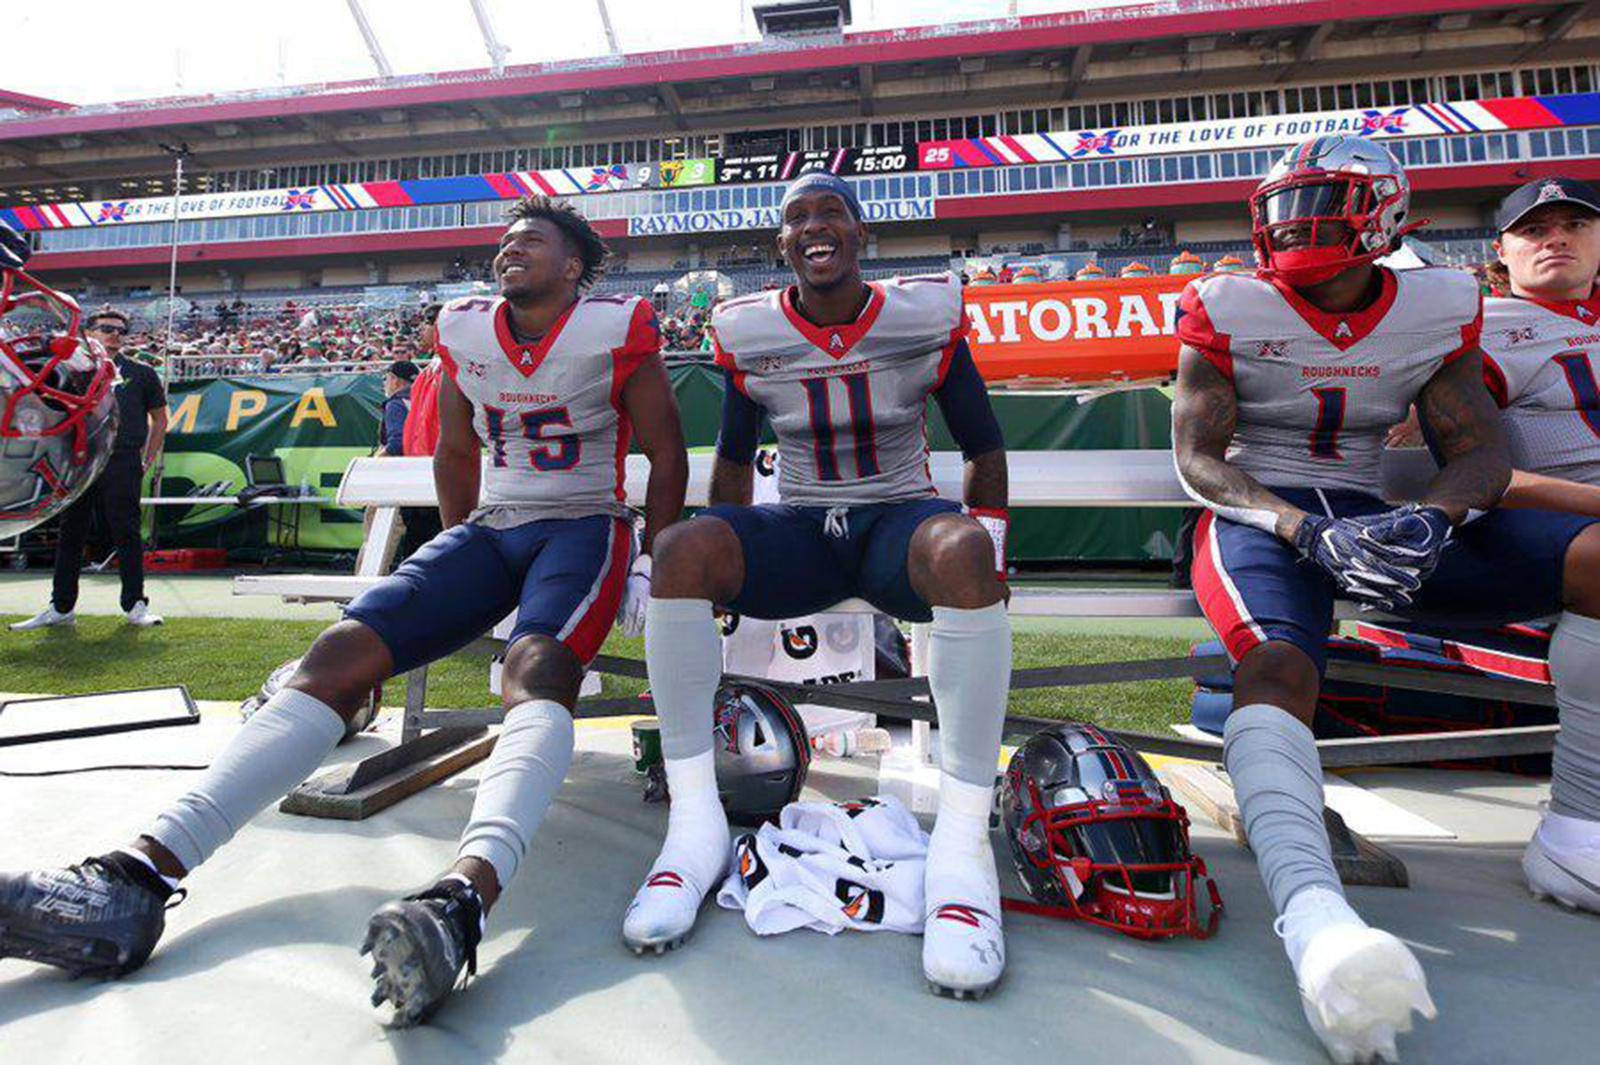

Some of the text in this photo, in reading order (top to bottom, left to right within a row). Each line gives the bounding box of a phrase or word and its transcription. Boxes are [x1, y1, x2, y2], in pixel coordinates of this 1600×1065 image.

[1149, 130, 1181, 144] THE
[1189, 126, 1236, 142] LOVE
[1244, 124, 1267, 138] OF
[853, 155, 906, 172] 15:00
[924, 147, 950, 163] 25
[638, 166, 651, 182] 9
[757, 164, 779, 179] 11
[174, 199, 204, 212] OVE
[631, 208, 780, 234] RAYMOND JA
[1302, 366, 1381, 377] ROUGHNECKS
[800, 373, 880, 481] 11
[1311, 387, 1347, 460] 1
[484, 404, 582, 471] 15
